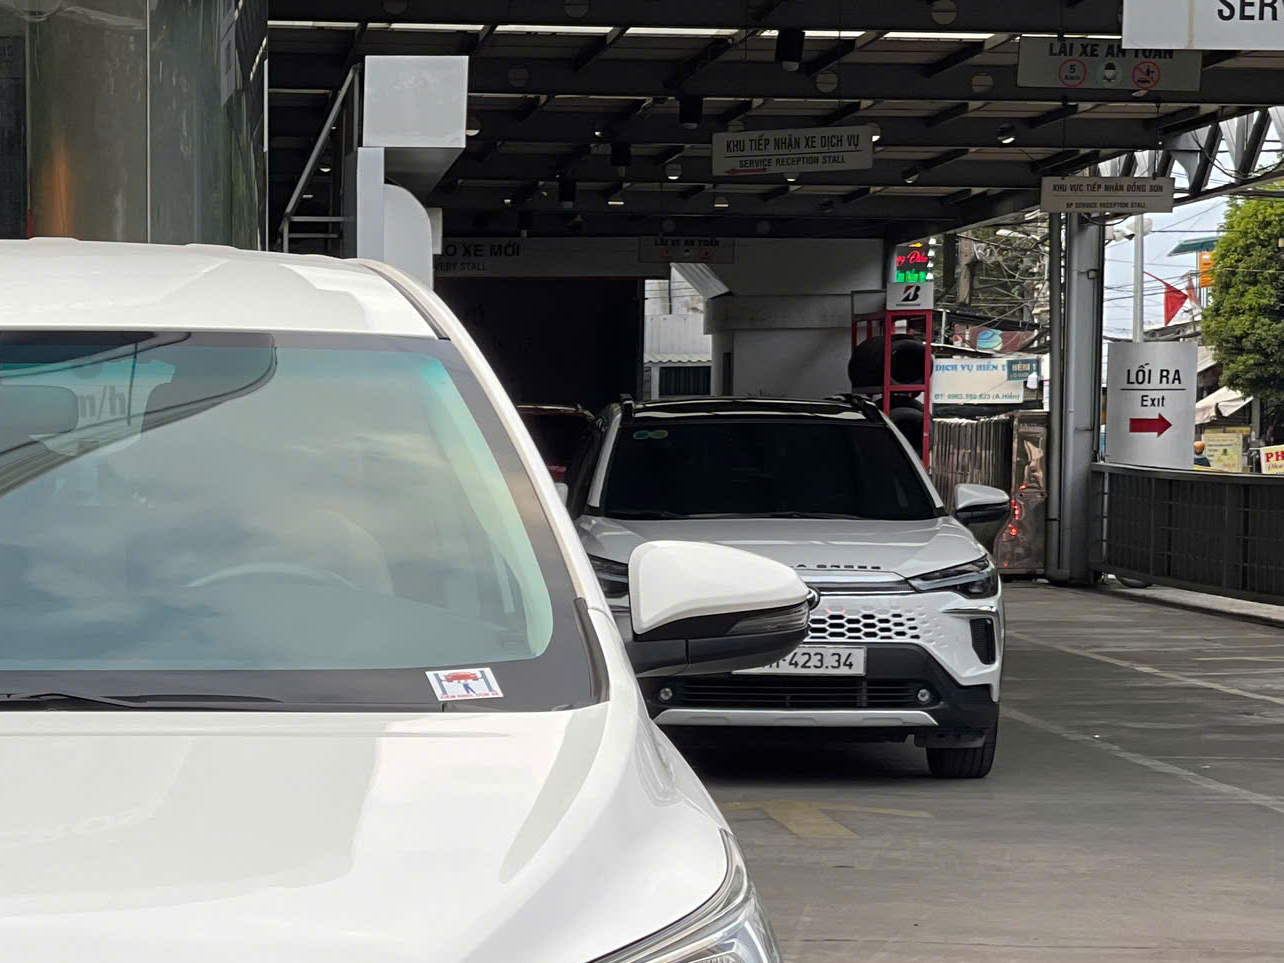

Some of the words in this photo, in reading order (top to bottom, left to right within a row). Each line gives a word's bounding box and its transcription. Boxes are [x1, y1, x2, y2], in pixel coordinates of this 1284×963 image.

[1217, 0, 1284, 21] SER
[1079, 43, 1099, 57] XE
[726, 140, 745, 152] KHU
[749, 134, 770, 151] TIẾP
[774, 134, 800, 152] NHẬN
[804, 136, 816, 149] XE
[820, 134, 843, 150] DỊCH
[847, 134, 860, 149] VỤ
[739, 157, 773, 168] SERVICE
[776, 155, 819, 167] RECEPTION
[822, 154, 846, 164] STALL
[462, 243, 485, 257] XE
[960, 364, 974, 372] VỤ
[1126, 363, 1152, 385] LỐI
[1159, 369, 1182, 385] RA
[1140, 394, 1165, 407] Exit
